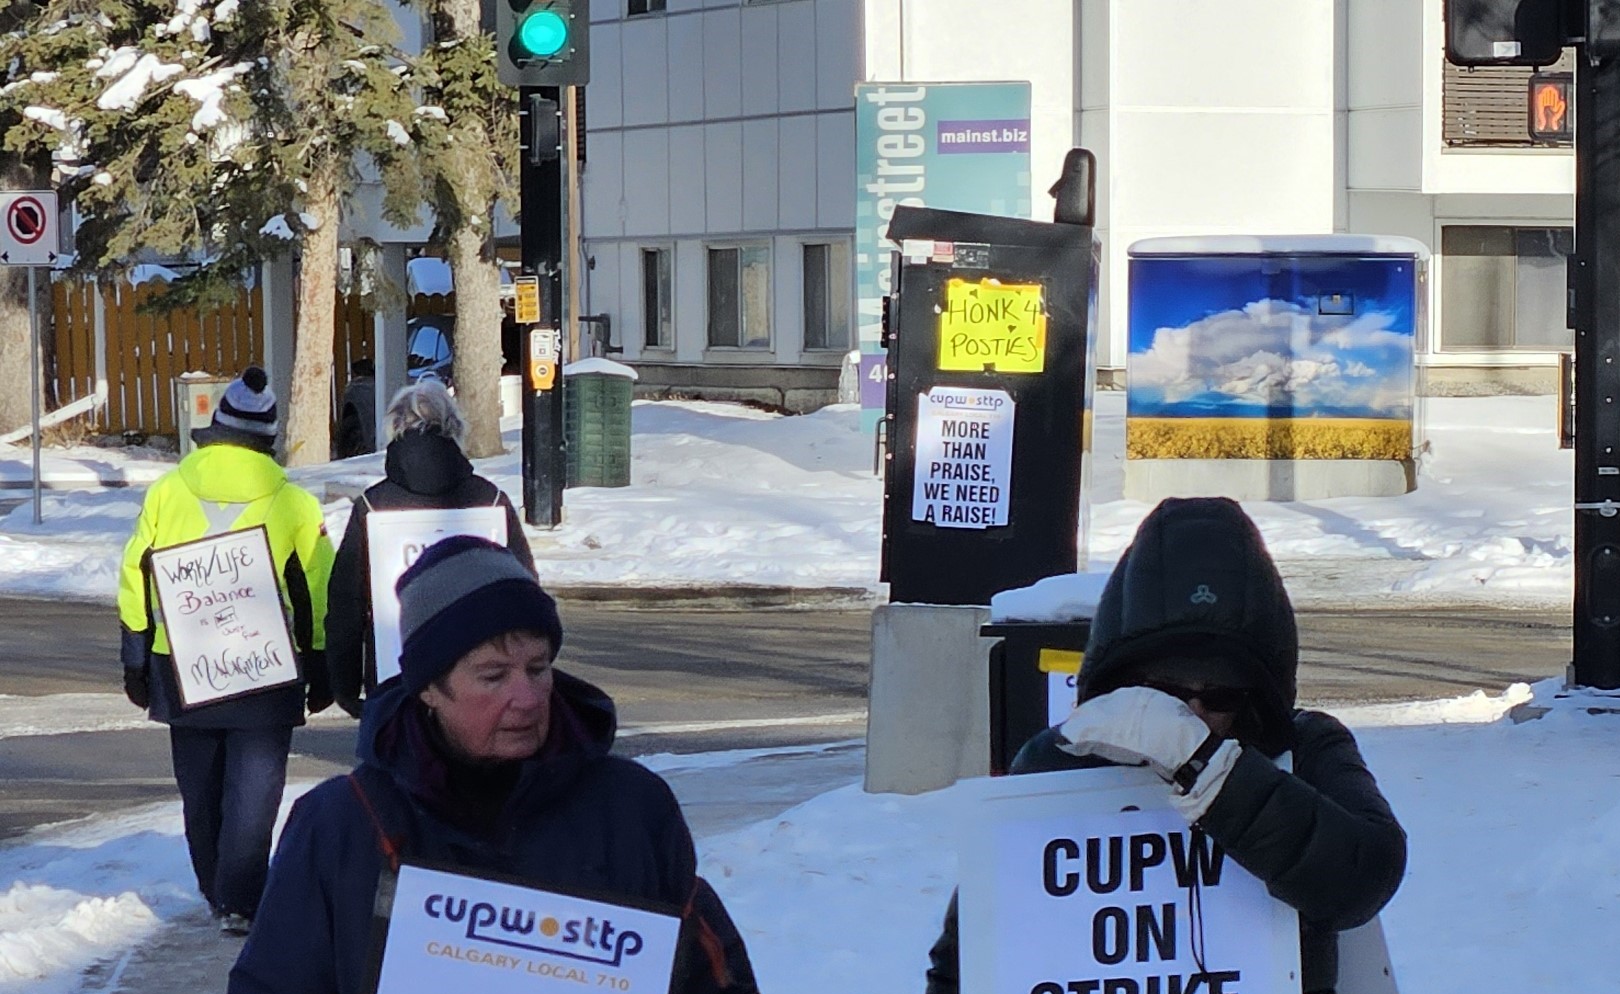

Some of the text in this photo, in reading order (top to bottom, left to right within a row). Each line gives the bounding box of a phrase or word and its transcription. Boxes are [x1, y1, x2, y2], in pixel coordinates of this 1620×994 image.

[941, 128, 1027, 143] mainst.biz
[949, 297, 1040, 326] HONK 4
[950, 333, 1038, 362] POSTIES
[942, 420, 991, 439] MORE
[943, 441, 986, 460] THAN
[930, 462, 995, 484] PRAISE,
[924, 483, 1000, 503] WE NEED
[925, 504, 996, 525] A RAISE!
[1043, 832, 1226, 897] CUPW
[1092, 902, 1177, 965] ON
[426, 941, 630, 992] CALGARY LOCAL 710
